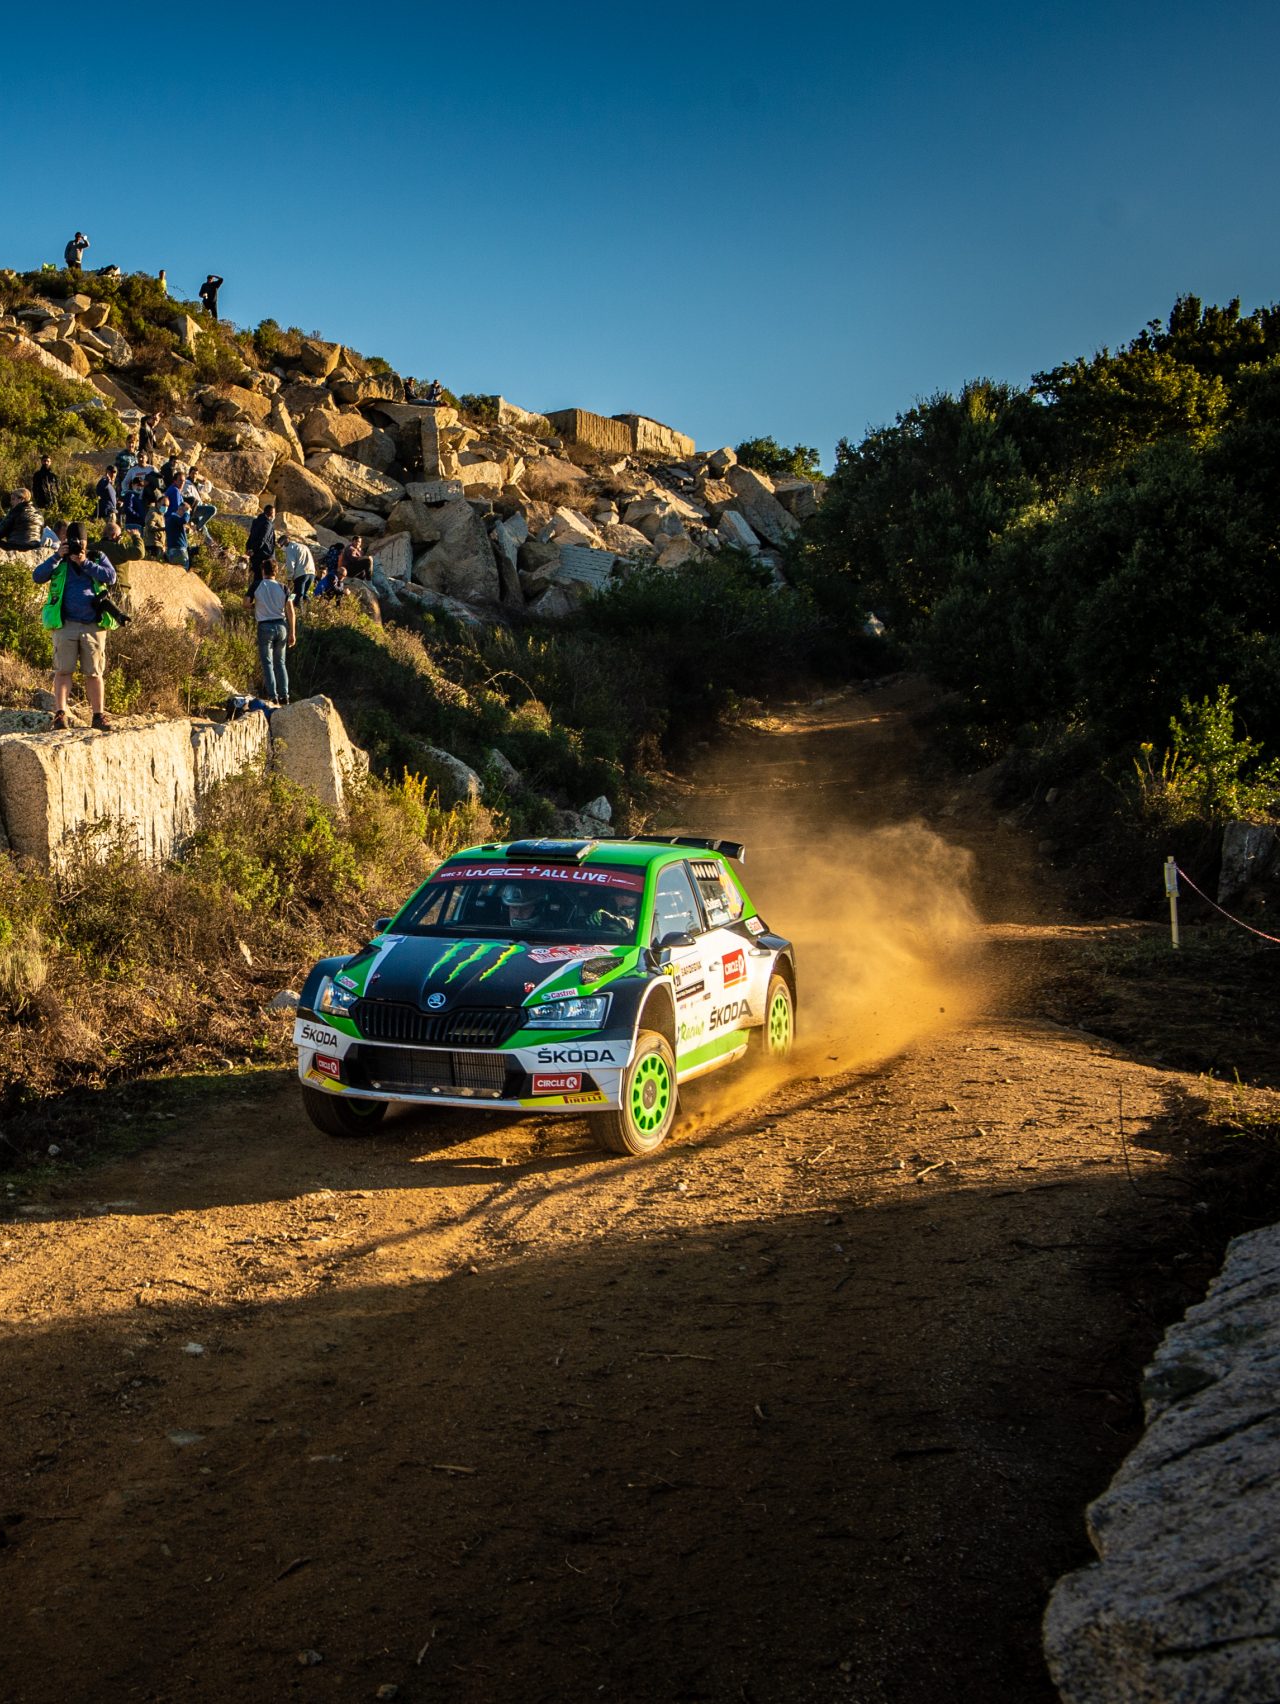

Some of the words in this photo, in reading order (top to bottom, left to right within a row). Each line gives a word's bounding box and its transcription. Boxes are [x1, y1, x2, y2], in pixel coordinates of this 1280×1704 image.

[539, 869, 569, 879] ALL
[572, 871, 608, 883] LIVE
[724, 960, 740, 976] CIRCLE
[550, 988, 576, 998] Castrol
[709, 998, 754, 1032] ŠKODA
[301, 1024, 338, 1048] ŠKODA
[537, 1048, 616, 1064] ŠKODA
[537, 1079, 566, 1088] CIRCLE
[566, 1076, 578, 1089] K
[563, 1090, 602, 1104] PIRELLI
